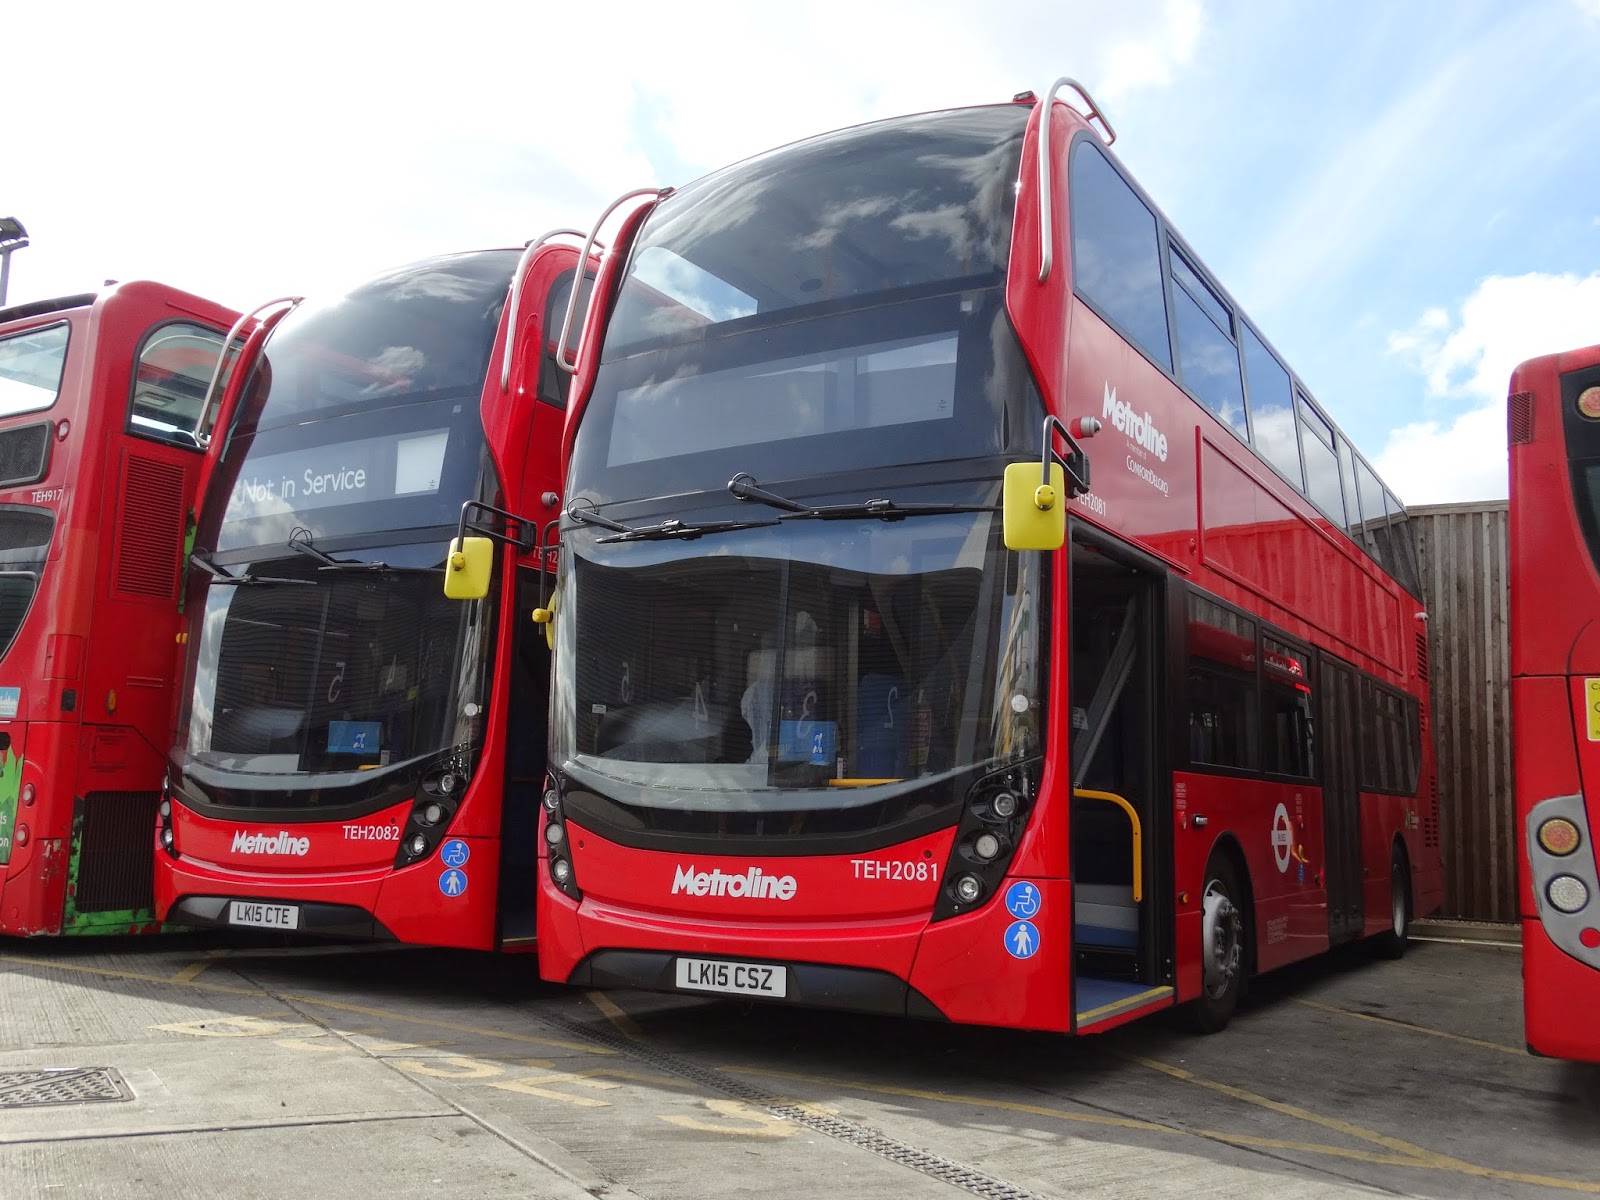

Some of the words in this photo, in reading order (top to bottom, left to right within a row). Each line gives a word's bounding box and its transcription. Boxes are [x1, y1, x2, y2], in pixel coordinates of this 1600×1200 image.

[1102, 380, 1168, 462] Metroline
[31, 489, 63, 503] TEH917
[242, 477, 274, 504] Not
[281, 476, 295, 498] in
[302, 467, 366, 496] Service
[230, 830, 310, 856] Metroline
[342, 825, 400, 841] TEH2082
[671, 864, 797, 901] Metroline
[850, 859, 938, 882] TEH2081
[236, 904, 263, 922] LK15
[265, 906, 291, 925] CTE
[687, 962, 729, 987] LK15
[734, 966, 773, 991] CSZ
